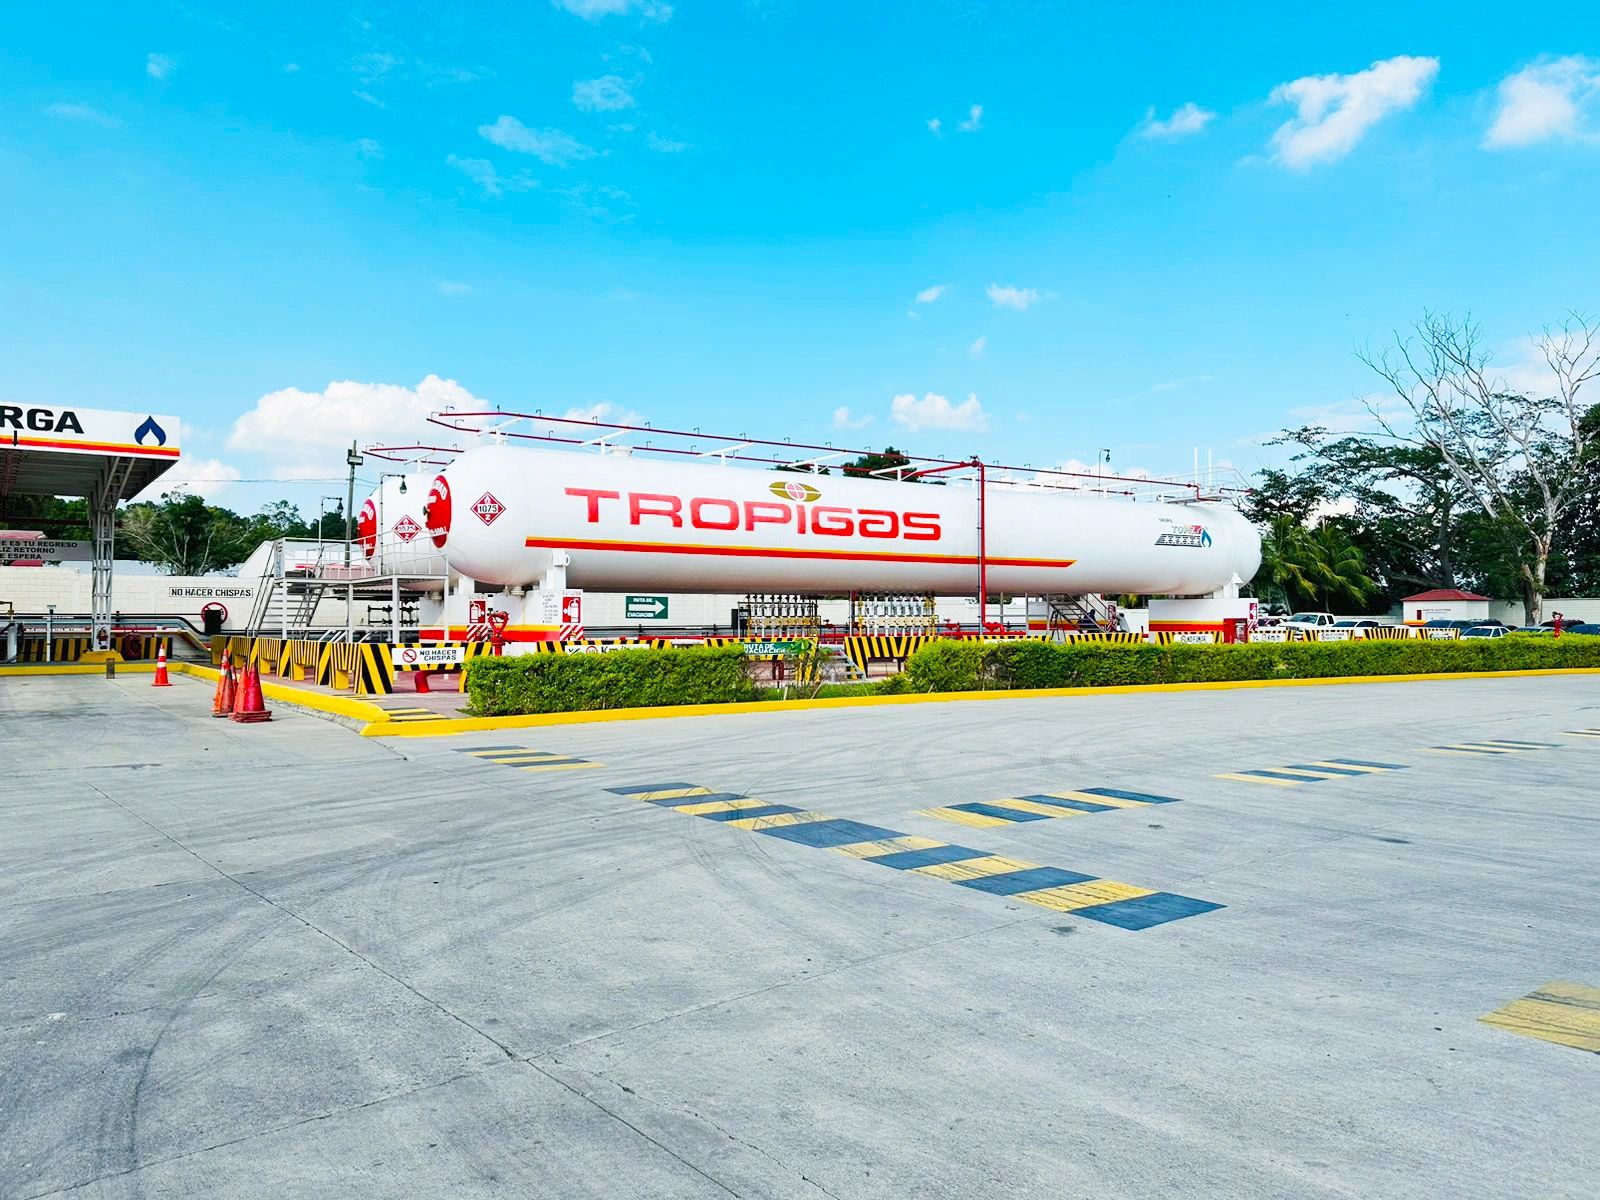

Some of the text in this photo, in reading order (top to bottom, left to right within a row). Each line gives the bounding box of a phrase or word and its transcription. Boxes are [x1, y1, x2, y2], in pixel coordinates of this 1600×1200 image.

[479, 504, 498, 513] 1075
[171, 588, 251, 597] NO HACER CHISPAS
